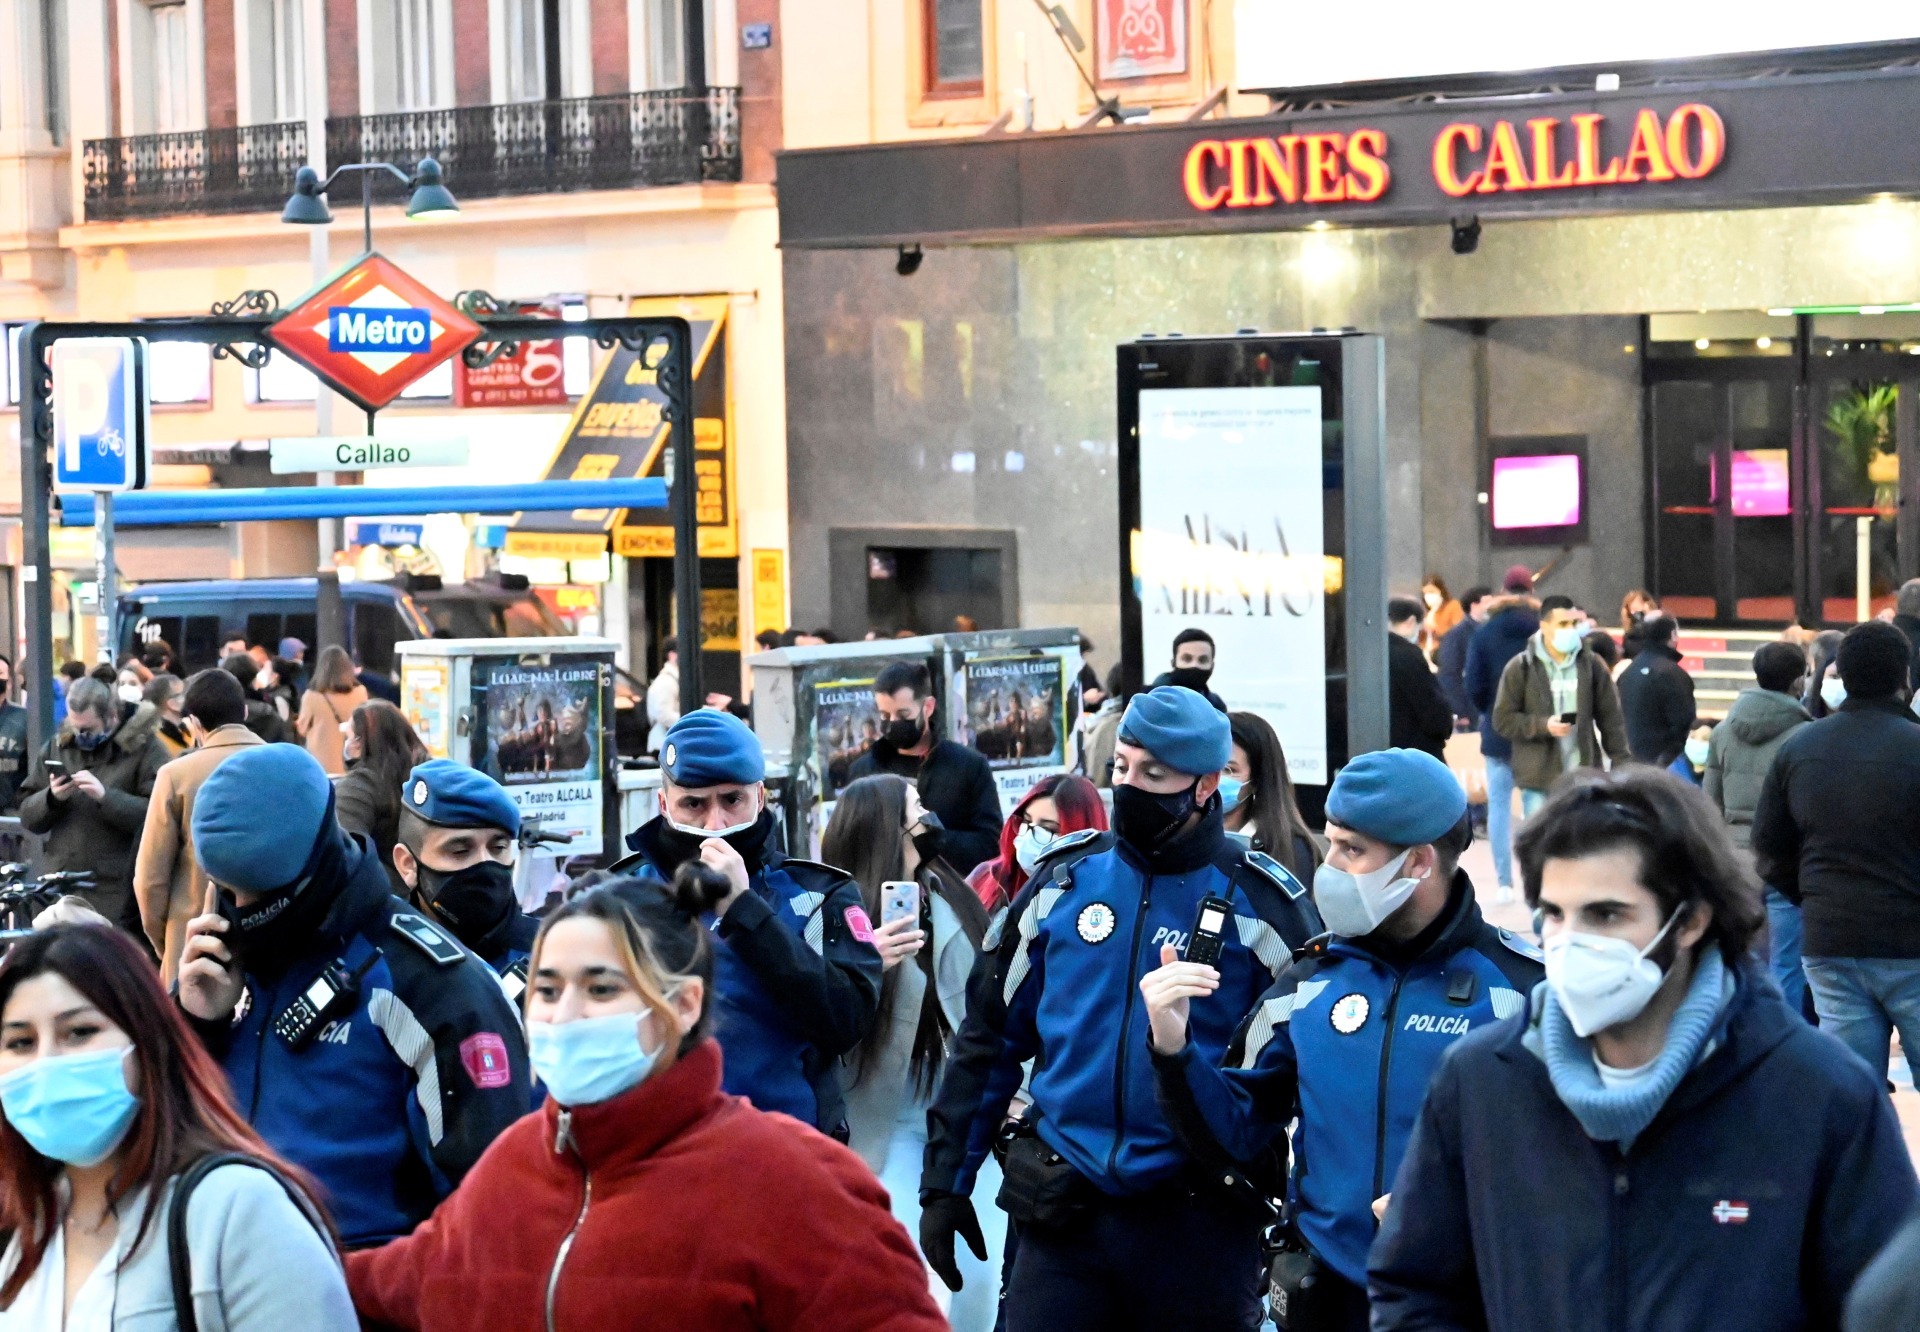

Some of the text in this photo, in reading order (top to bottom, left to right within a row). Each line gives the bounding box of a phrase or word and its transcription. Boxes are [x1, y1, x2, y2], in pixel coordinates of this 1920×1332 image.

[1183, 102, 1726, 211] CINES CALLAO
[338, 311, 425, 345] Metro
[73, 359, 109, 472] P
[336, 443, 410, 464] Callao
[1404, 1013, 1470, 1035] POLICÍA
